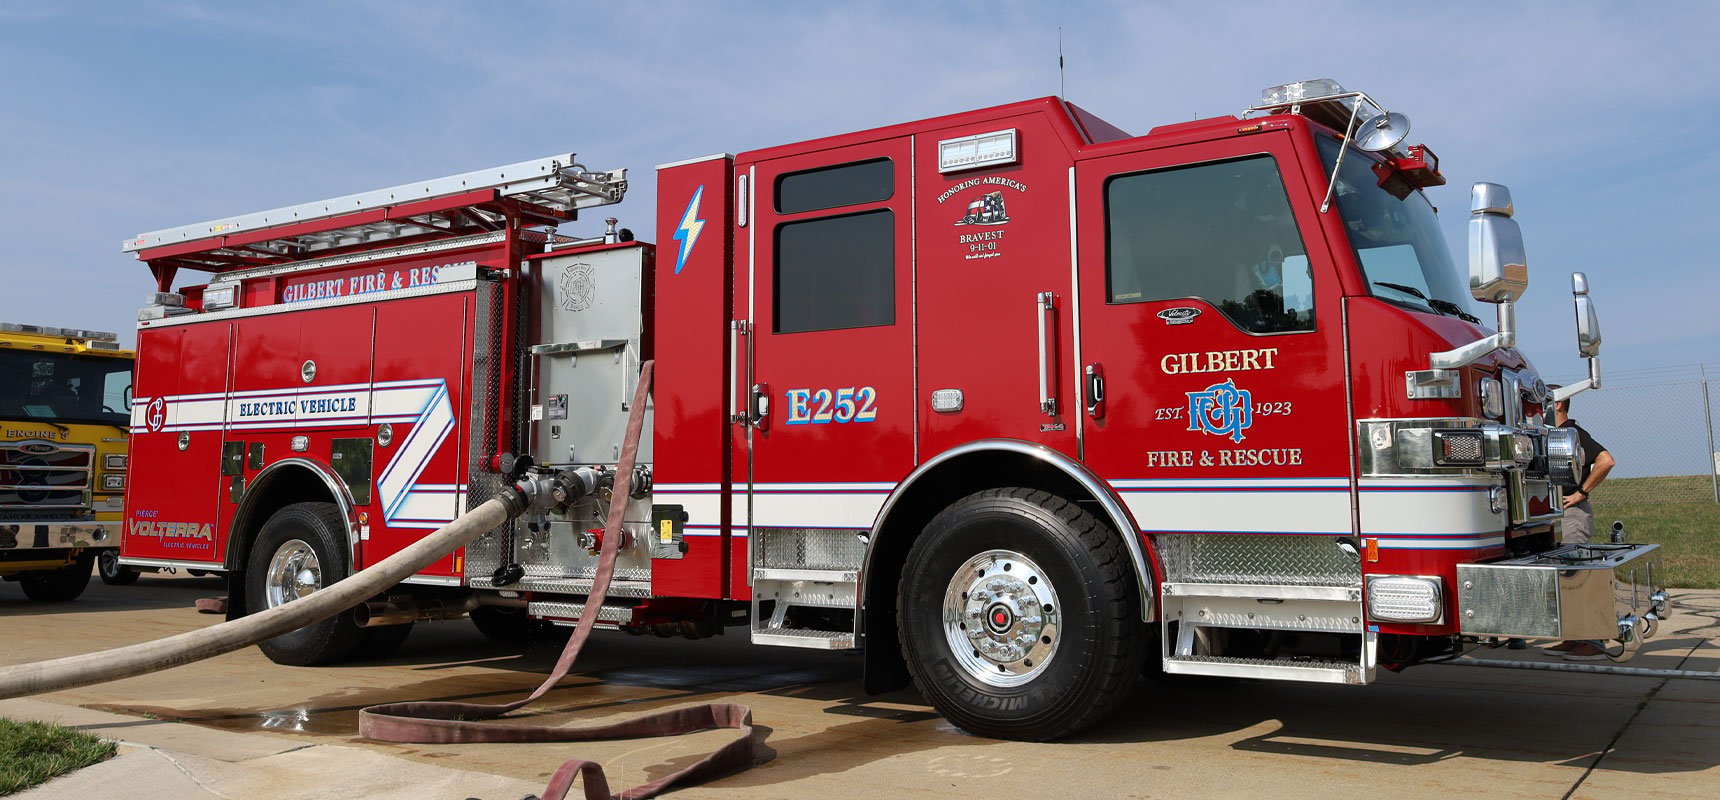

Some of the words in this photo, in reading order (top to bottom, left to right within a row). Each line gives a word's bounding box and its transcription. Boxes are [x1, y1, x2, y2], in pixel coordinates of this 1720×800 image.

[937, 178, 980, 203] HONORING
[982, 176, 1027, 192] AMERICA'S
[960, 230, 1005, 243] BRAVEST
[969, 242, 996, 252] 9-11-01
[283, 278, 344, 303] GILBERT
[350, 271, 386, 295] FIRE
[390, 270, 403, 290] &
[409, 261, 475, 288] RES
[1160, 348, 1278, 374] GILBERT
[239, 401, 296, 417] ELECTRIC
[300, 398, 357, 413] VEHICLE
[785, 386, 878, 425] E252
[1155, 406, 1184, 420] EST.
[1256, 402, 1292, 416] 1923
[6, 429, 57, 438] ENGINE
[1146, 451, 1194, 467] FIRE
[1199, 450, 1214, 466] &
[1219, 448, 1302, 466] RESCUE
